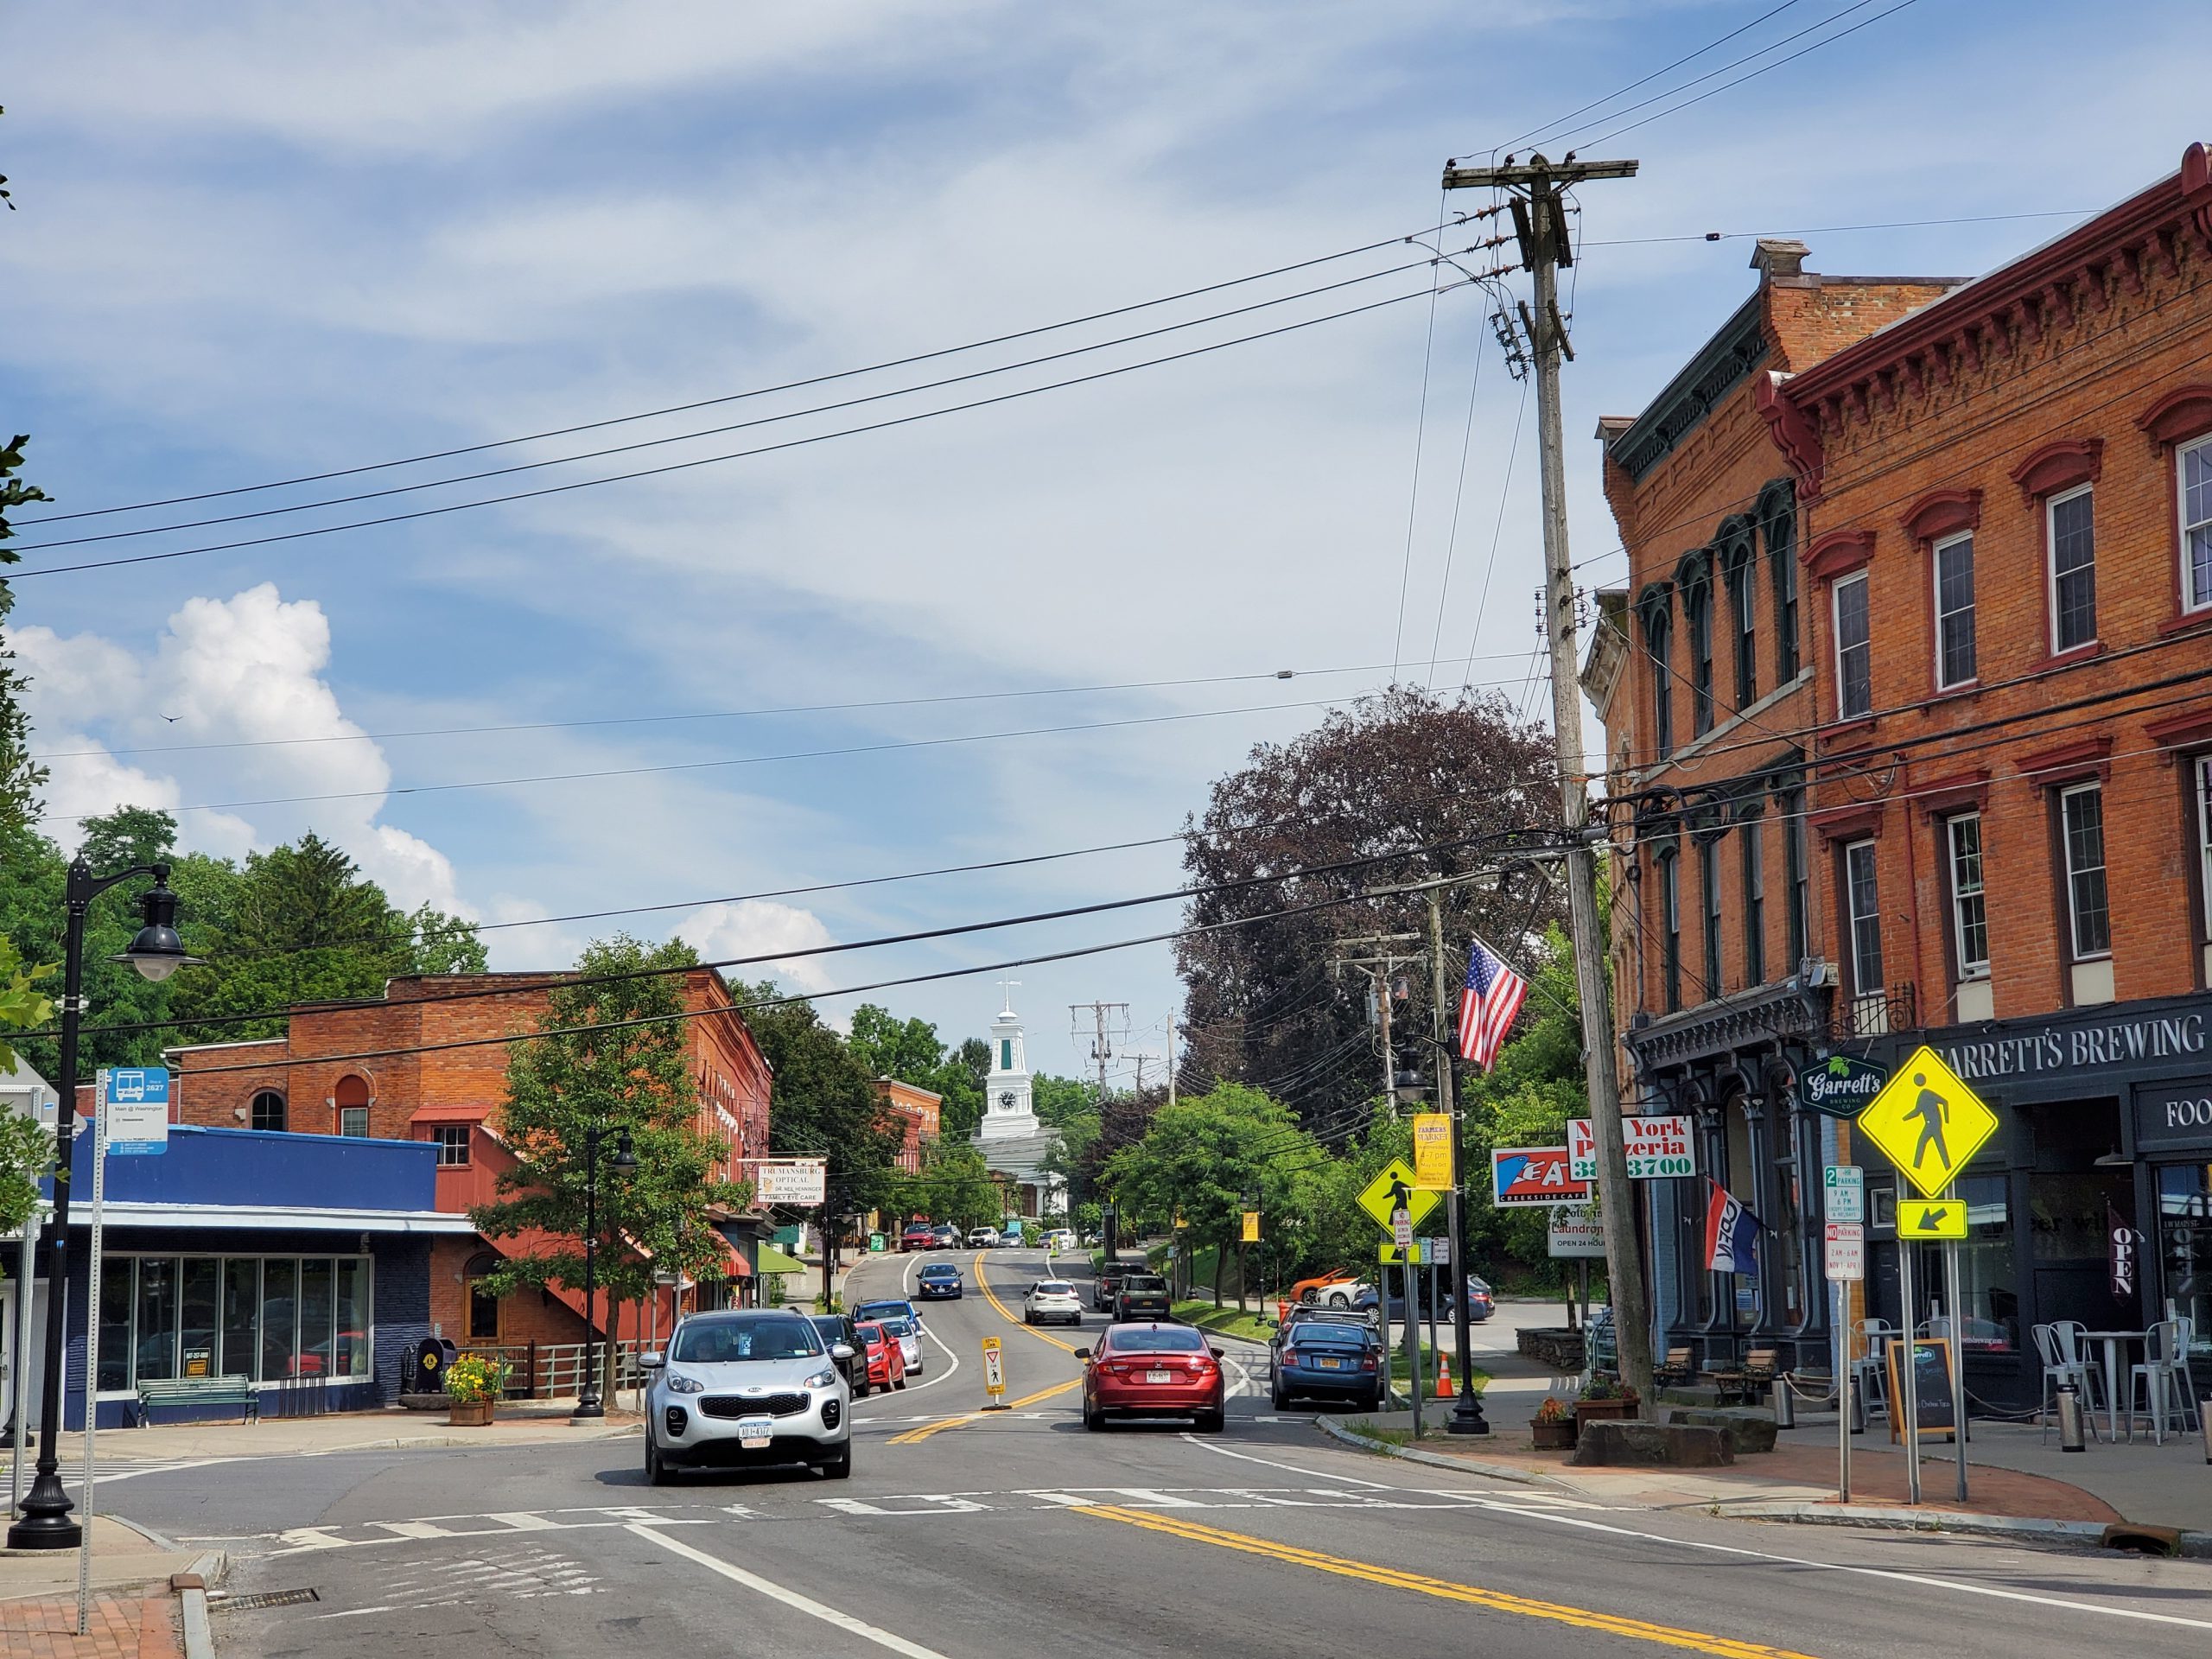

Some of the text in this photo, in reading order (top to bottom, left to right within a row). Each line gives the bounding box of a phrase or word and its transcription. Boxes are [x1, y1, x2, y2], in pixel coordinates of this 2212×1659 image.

[2070, 1014, 2205, 1066] BREWING
[1808, 1072, 1881, 1101] Garrett's
[1630, 1118, 1685, 1137] York
[1576, 1137, 1686, 1158] Pzeria
[1574, 1158, 1691, 1177] 383700
[1827, 1170, 1835, 1183] 2
[1500, 1193, 1556, 1202] CREEKSIDE
[1552, 1224, 1604, 1234] Laundrom
[1827, 1227, 1837, 1238] NO
[2113, 1228, 2133, 1294] OPEN
